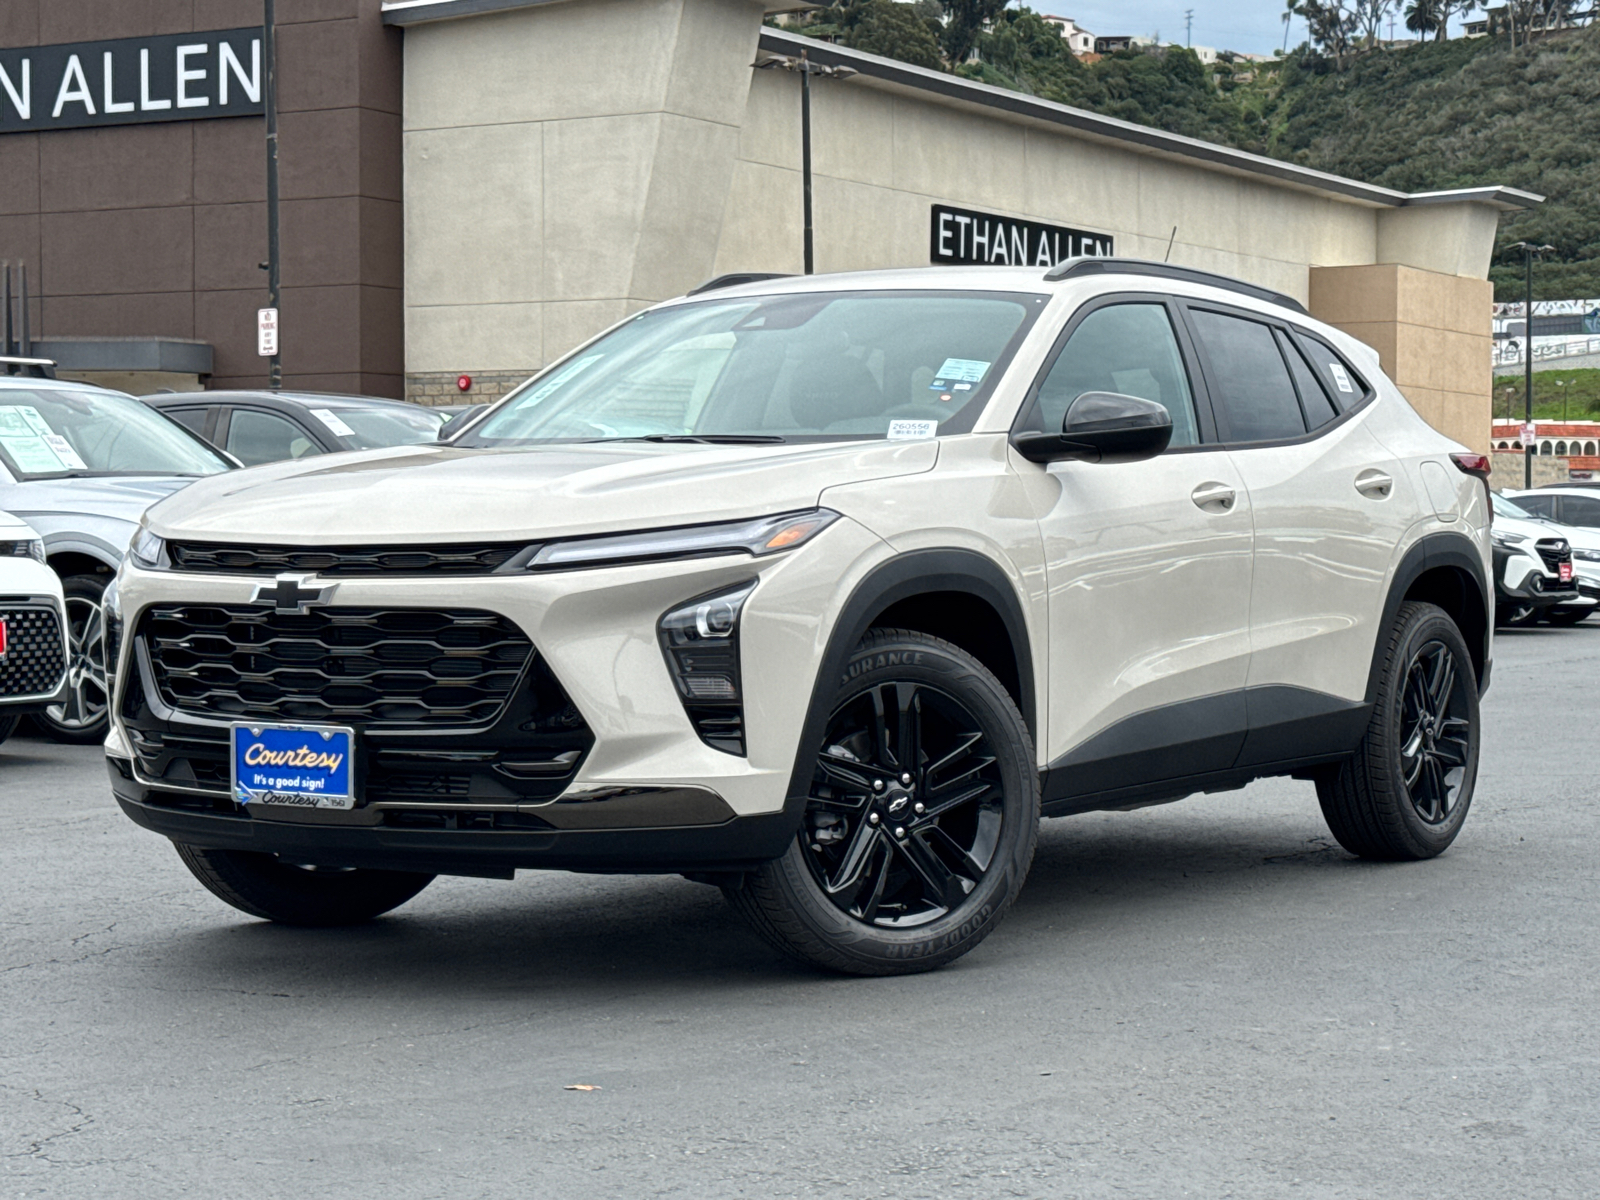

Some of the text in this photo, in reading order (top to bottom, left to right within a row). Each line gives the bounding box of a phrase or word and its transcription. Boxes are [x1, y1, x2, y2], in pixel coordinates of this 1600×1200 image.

[52, 39, 261, 118] ALLEN
[938, 211, 1028, 267] ETHAN
[245, 743, 343, 774] Courtesy
[254, 774, 325, 791] It's a good sign!
[262, 790, 320, 807] Courtesy
